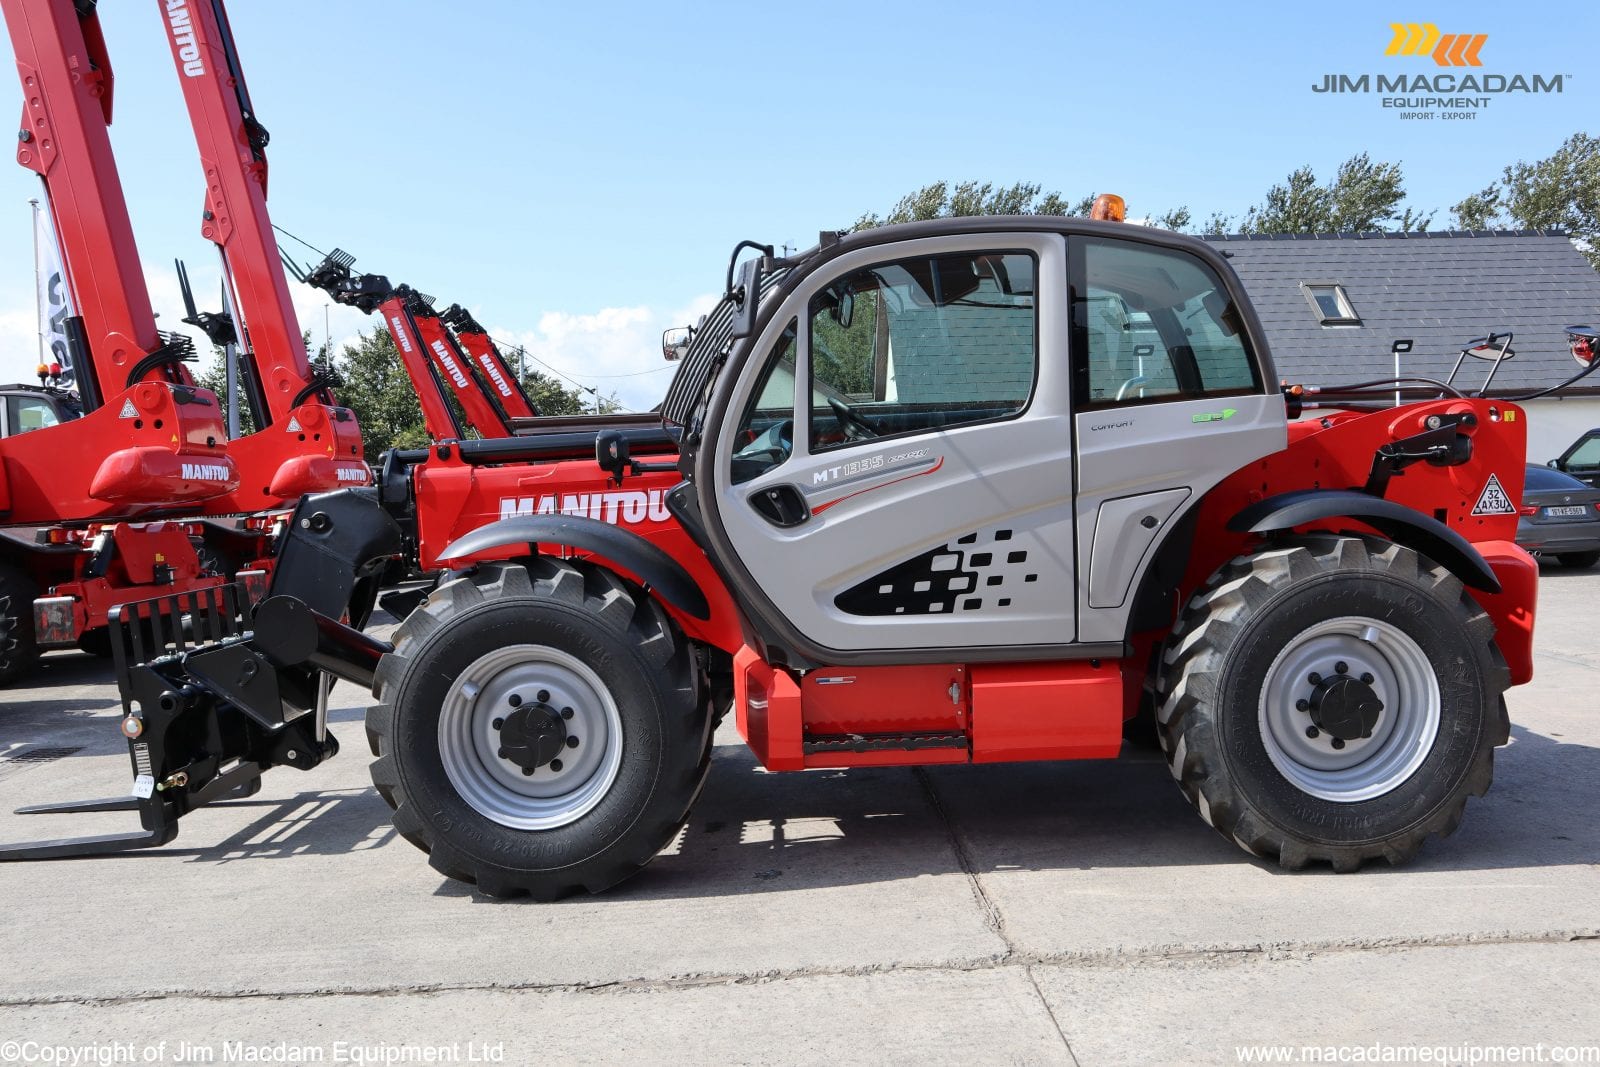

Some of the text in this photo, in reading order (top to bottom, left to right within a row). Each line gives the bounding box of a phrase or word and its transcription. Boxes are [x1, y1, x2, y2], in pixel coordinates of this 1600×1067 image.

[391, 316, 413, 353] MANITOU
[431, 339, 469, 389] MANITOU
[479, 353, 513, 397] MANITOU
[181, 463, 230, 481] MANITOU
[336, 468, 367, 481] MANITOU
[813, 466, 841, 485] MT
[842, 455, 884, 476] 1335
[500, 488, 671, 525] MANITOU
[1481, 500, 1506, 510] AX3U
[1487, 489, 1500, 500] 32
